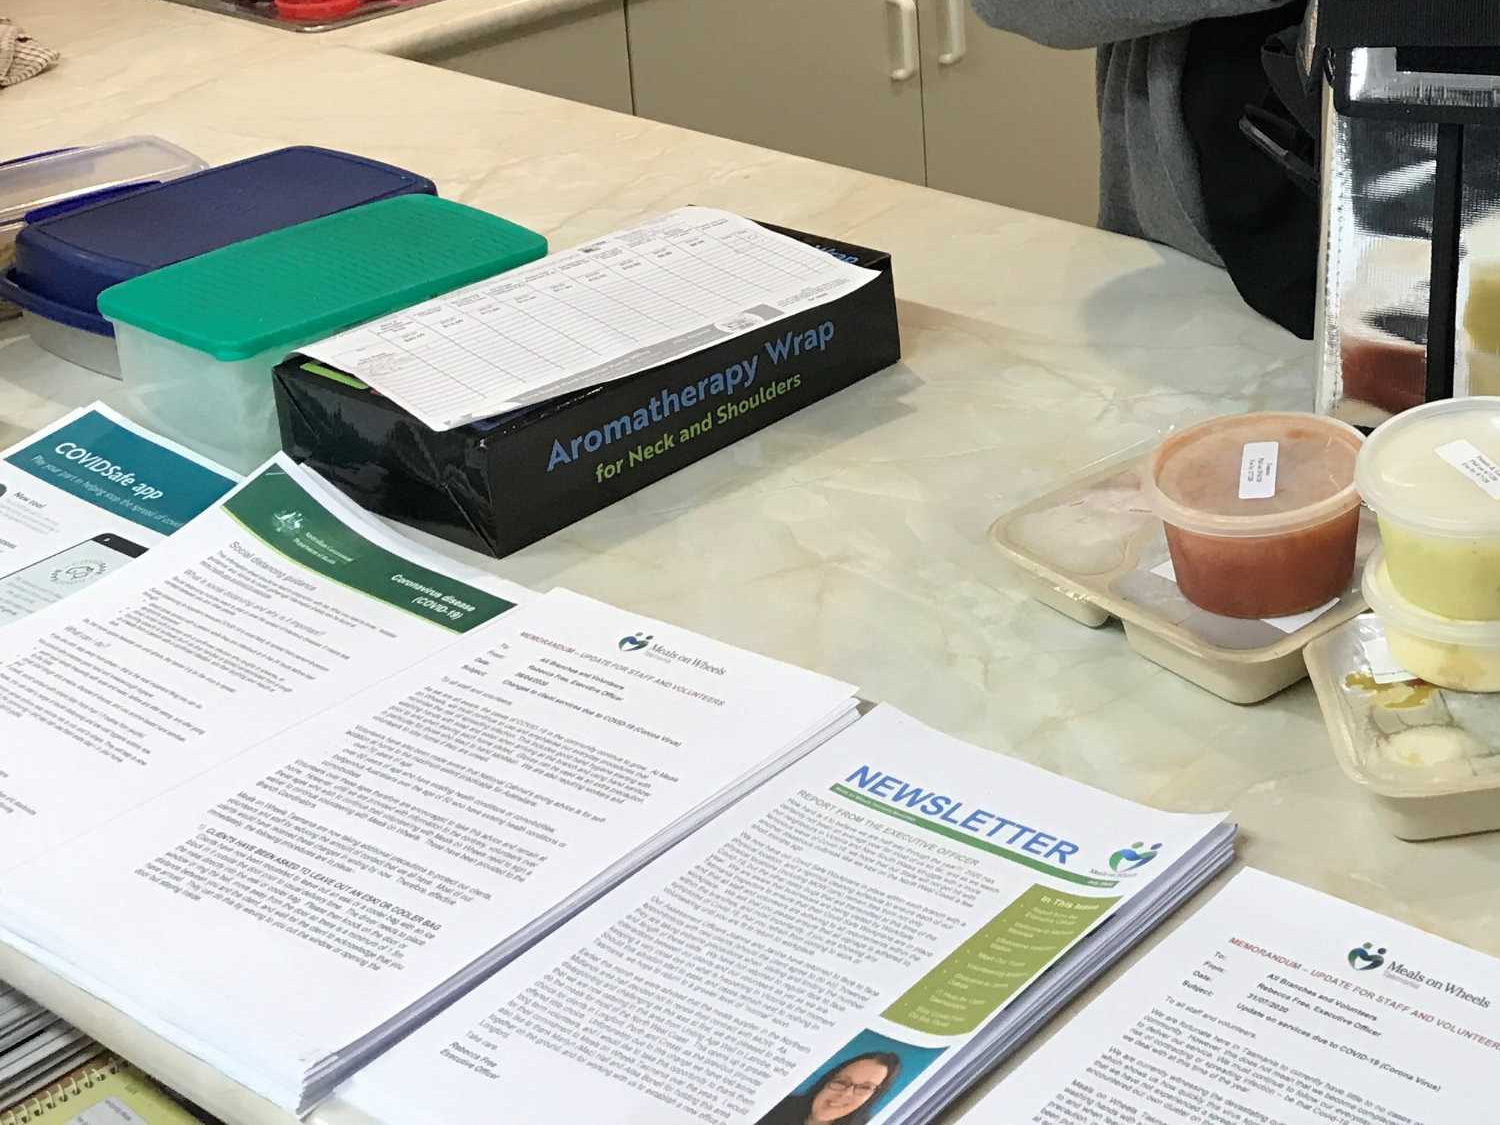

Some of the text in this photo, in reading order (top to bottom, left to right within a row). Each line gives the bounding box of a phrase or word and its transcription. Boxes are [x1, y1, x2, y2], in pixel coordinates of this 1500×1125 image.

[546, 320, 835, 473] Aromatherapy Wrap
[594, 374, 802, 483] for Neck and Shoulders
[54, 442, 164, 501] COVIDSafe app
[391, 574, 477, 613] Coronavirus disease
[411, 595, 464, 621] (COVID-19)
[651, 643, 678, 660] Meals
[677, 655, 692, 665] on
[691, 658, 727, 676] Wheels
[796, 789, 837, 812] REPORT
[835, 808, 865, 823] FROM
[864, 819, 884, 831] THE
[882, 826, 938, 852] EXECUTIVE
[936, 847, 980, 867] OFFICER
[845, 765, 1080, 865] NEWSLETTER
[1228, 937, 1302, 970] MEMORANDUM
[1310, 969, 1353, 990] UPDATE
[1352, 986, 1376, 1000] FOR
[1375, 995, 1411, 1012] STAFF
[1410, 1010, 1435, 1023] AND
[1256, 982, 1292, 1001] Rebecca
[1313, 1005, 1353, 1026] Executive
[1353, 1022, 1382, 1037] Officer
[1267, 973, 1378, 1021] All Branches and Volunteers
[1386, 960, 1491, 1009] Meals on Wheels
[1236, 1002, 1441, 1092] Update on services due to COVID-19 (Corona Virus)
